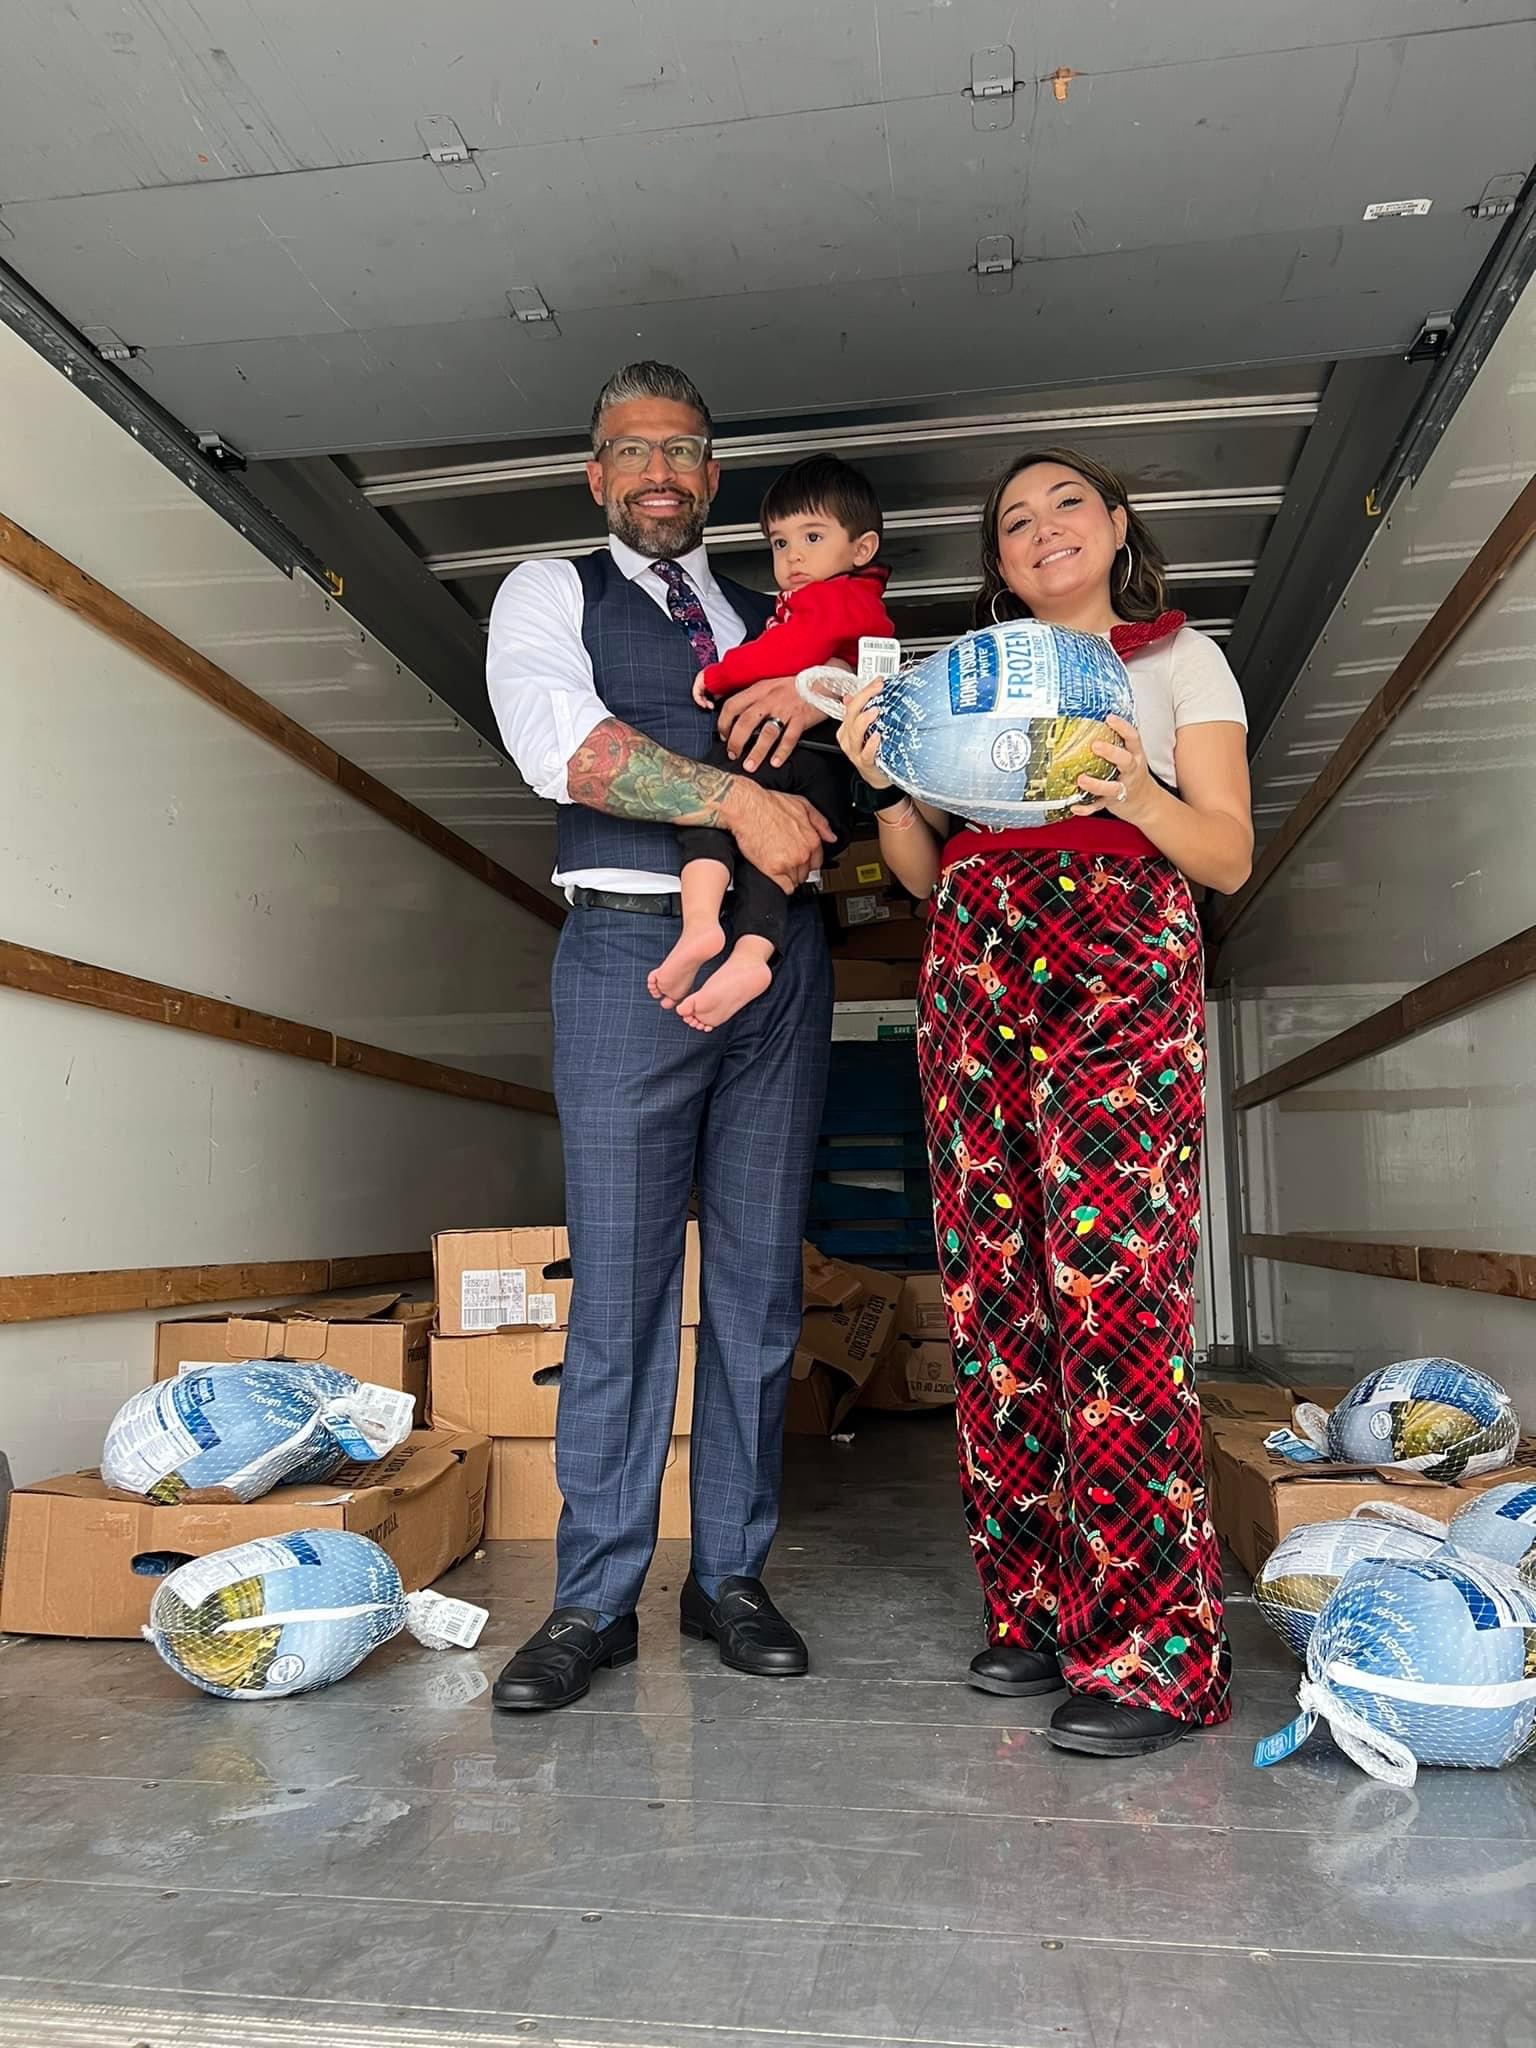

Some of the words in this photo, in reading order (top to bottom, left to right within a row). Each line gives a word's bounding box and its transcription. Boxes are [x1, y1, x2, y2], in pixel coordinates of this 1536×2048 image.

[979, 648, 990, 679] WHITE
[1004, 631, 1032, 698] FROZEN
[1034, 660, 1046, 688] YOUNG
[263, 1409, 302, 1431] frozen
[1378, 1632, 1424, 1682] frozen
